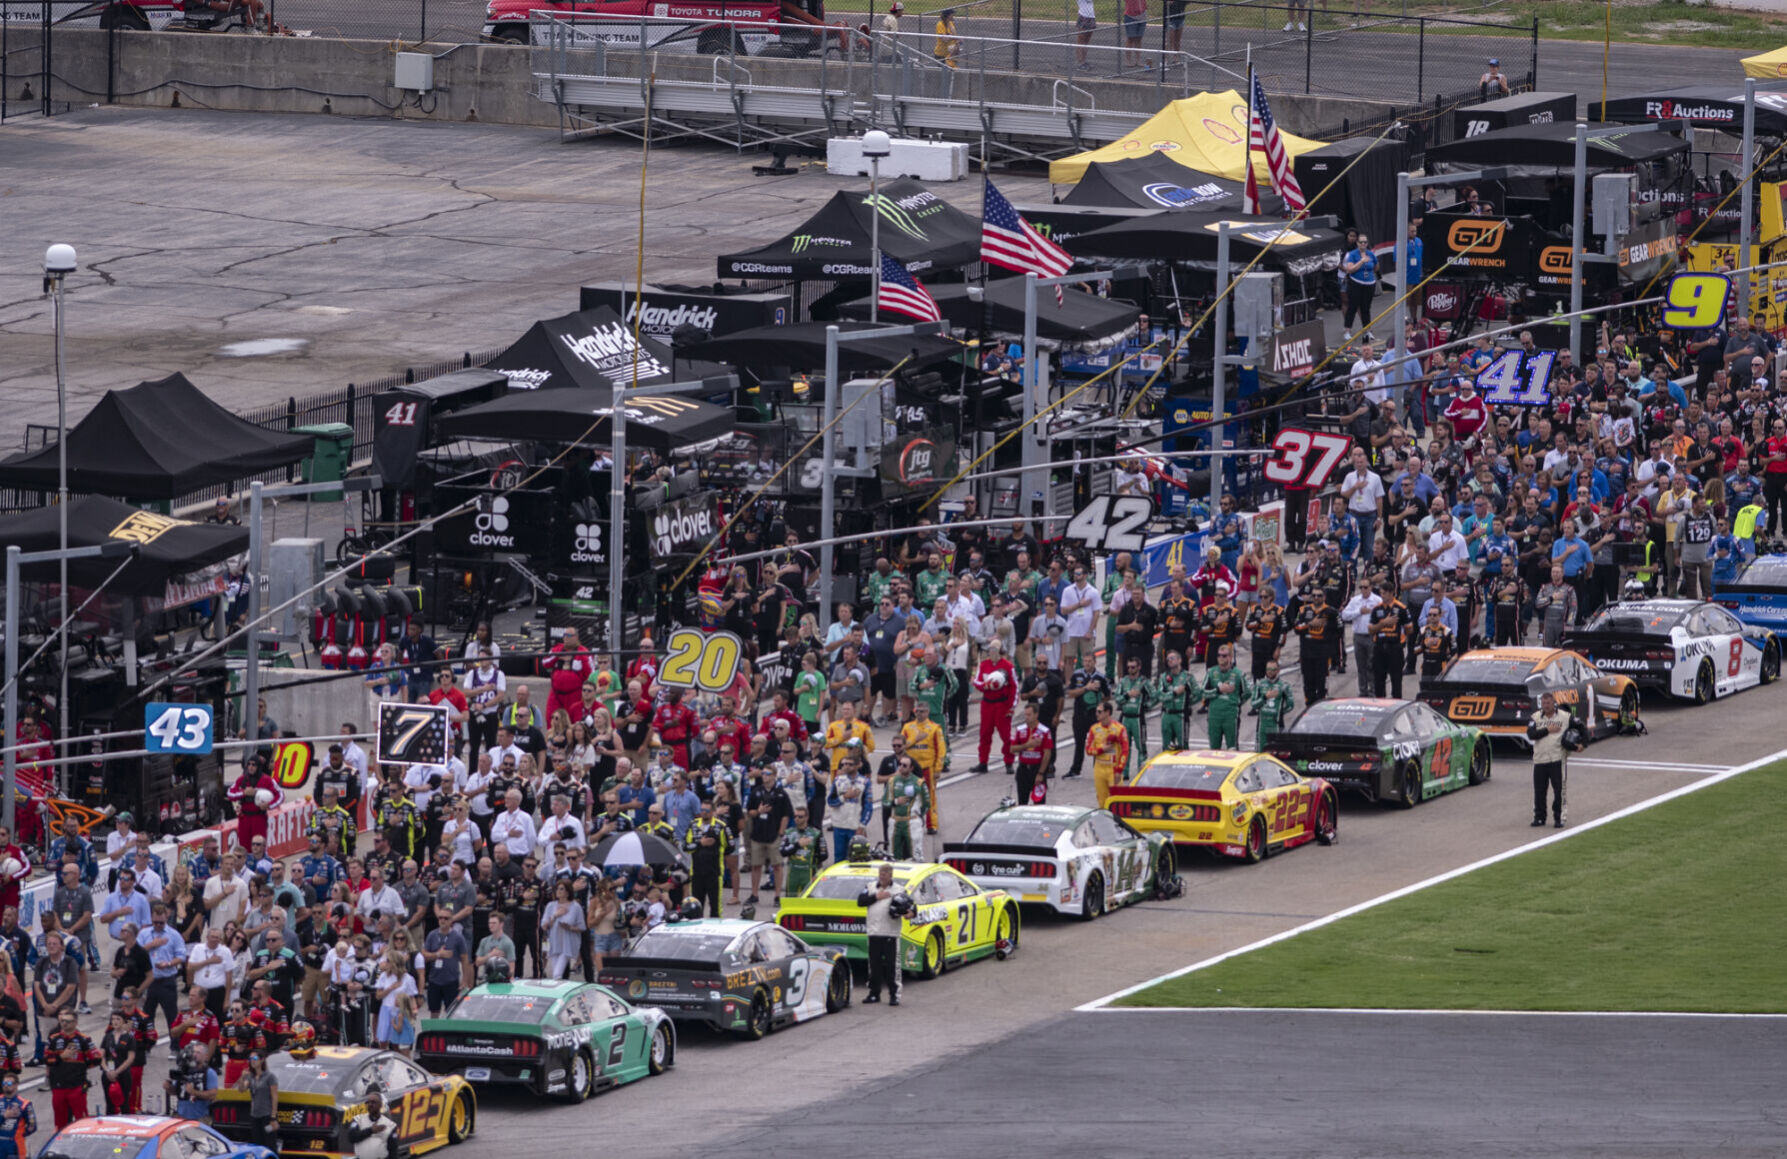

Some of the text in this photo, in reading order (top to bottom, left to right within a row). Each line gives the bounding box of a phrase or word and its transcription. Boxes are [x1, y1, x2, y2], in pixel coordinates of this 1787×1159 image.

[14, 12, 40, 20] TEAM
[670, 8, 762, 18] TOYOTA TUNDRA
[612, 33, 640, 43] TEAM
[1630, 235, 1676, 263] GEARWRENCH
[731, 263, 793, 274] @CGRteams
[823, 264, 881, 275] @CGRteam
[1447, 257, 1506, 268] GEARWRENCH
[1539, 275, 1586, 285] GEARWREH
[1664, 275, 1728, 328] 9
[626, 301, 717, 329] Hendrick
[560, 321, 641, 368] Hendrick
[1476, 350, 1556, 406] 41
[385, 401, 418, 426] 41
[1264, 429, 1353, 489] 37
[670, 508, 712, 544] clover
[1064, 494, 1150, 551] 42
[469, 531, 514, 547] clover
[1688, 527, 1711, 541] 129
[570, 550, 605, 563] clover
[1165, 539, 1184, 576] 41
[577, 586, 594, 599] 42
[657, 628, 741, 692] 20
[1596, 659, 1649, 670] OKUMA
[1727, 637, 1743, 677] 8
[1337, 704, 1385, 713] clover
[1452, 699, 1493, 718] GW
[1516, 709, 1522, 719] 1
[1586, 683, 1596, 729] 1
[149, 707, 211, 749] 43
[390, 709, 436, 757] 7
[1308, 759, 1343, 771] clover
[1430, 737, 1453, 779] 42
[1360, 763, 1373, 771] 42
[1198, 832, 1213, 840] 22
[1117, 849, 1135, 891] 14
[957, 902, 977, 945] 21
[785, 958, 809, 1006] 3
[710, 990, 721, 999] 3
[446, 1044, 514, 1056] #AtlantaCash
[607, 1021, 628, 1069] 2
[285, 1062, 322, 1070] BLANEY
[309, 1139, 325, 1149] 12
